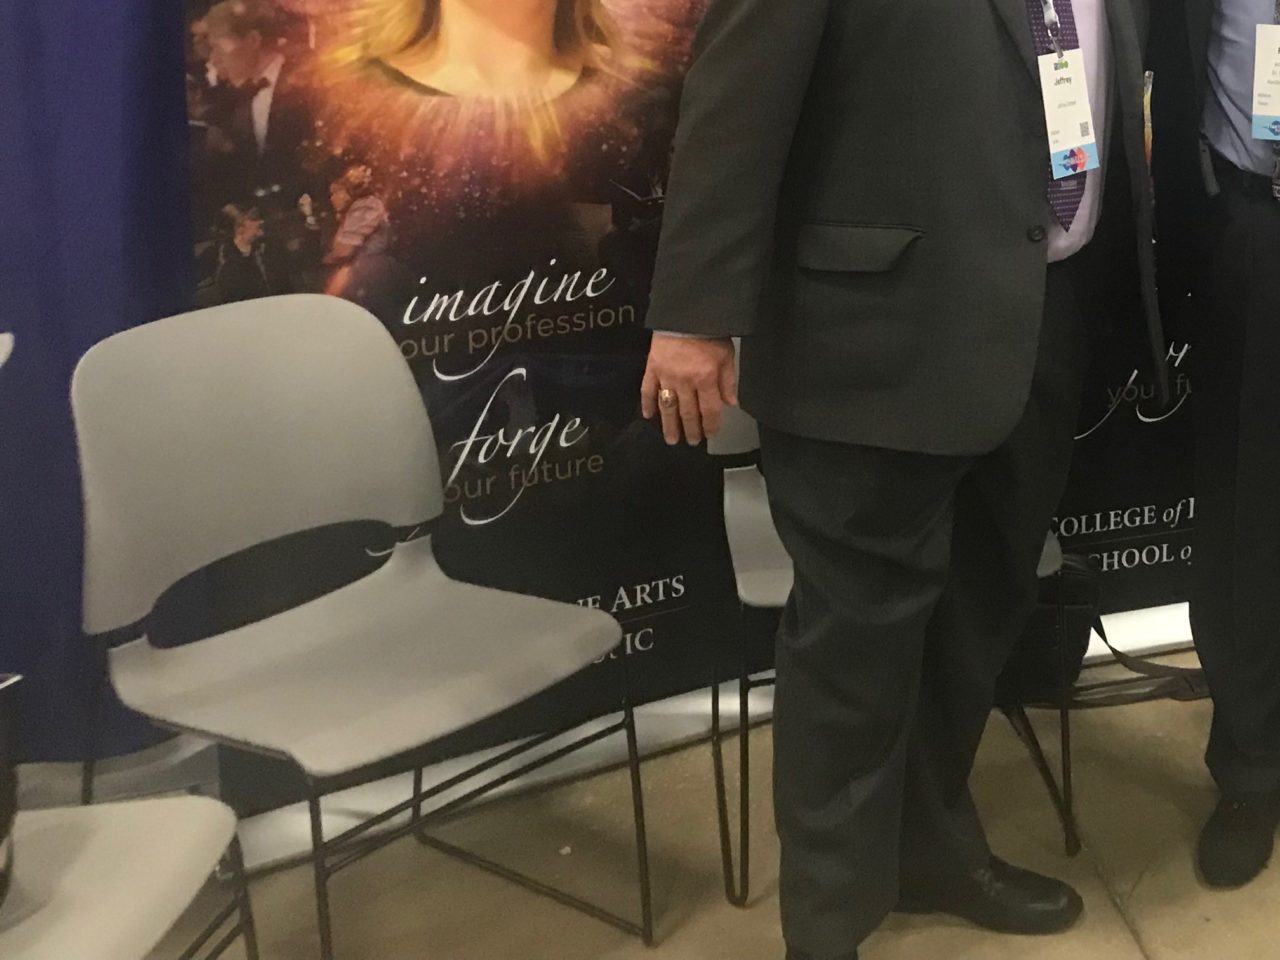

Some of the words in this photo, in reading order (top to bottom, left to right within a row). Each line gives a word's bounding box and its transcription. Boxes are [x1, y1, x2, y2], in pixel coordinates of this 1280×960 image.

[399, 330, 454, 361] our
[468, 301, 636, 355] profession
[403, 258, 617, 381] imagine
[445, 368, 589, 525] forge
[442, 474, 497, 503] our
[508, 454, 605, 491] future
[1162, 499, 1187, 528] of
[1088, 543, 1175, 572] HOOL
[610, 574, 686, 613] ARTS
